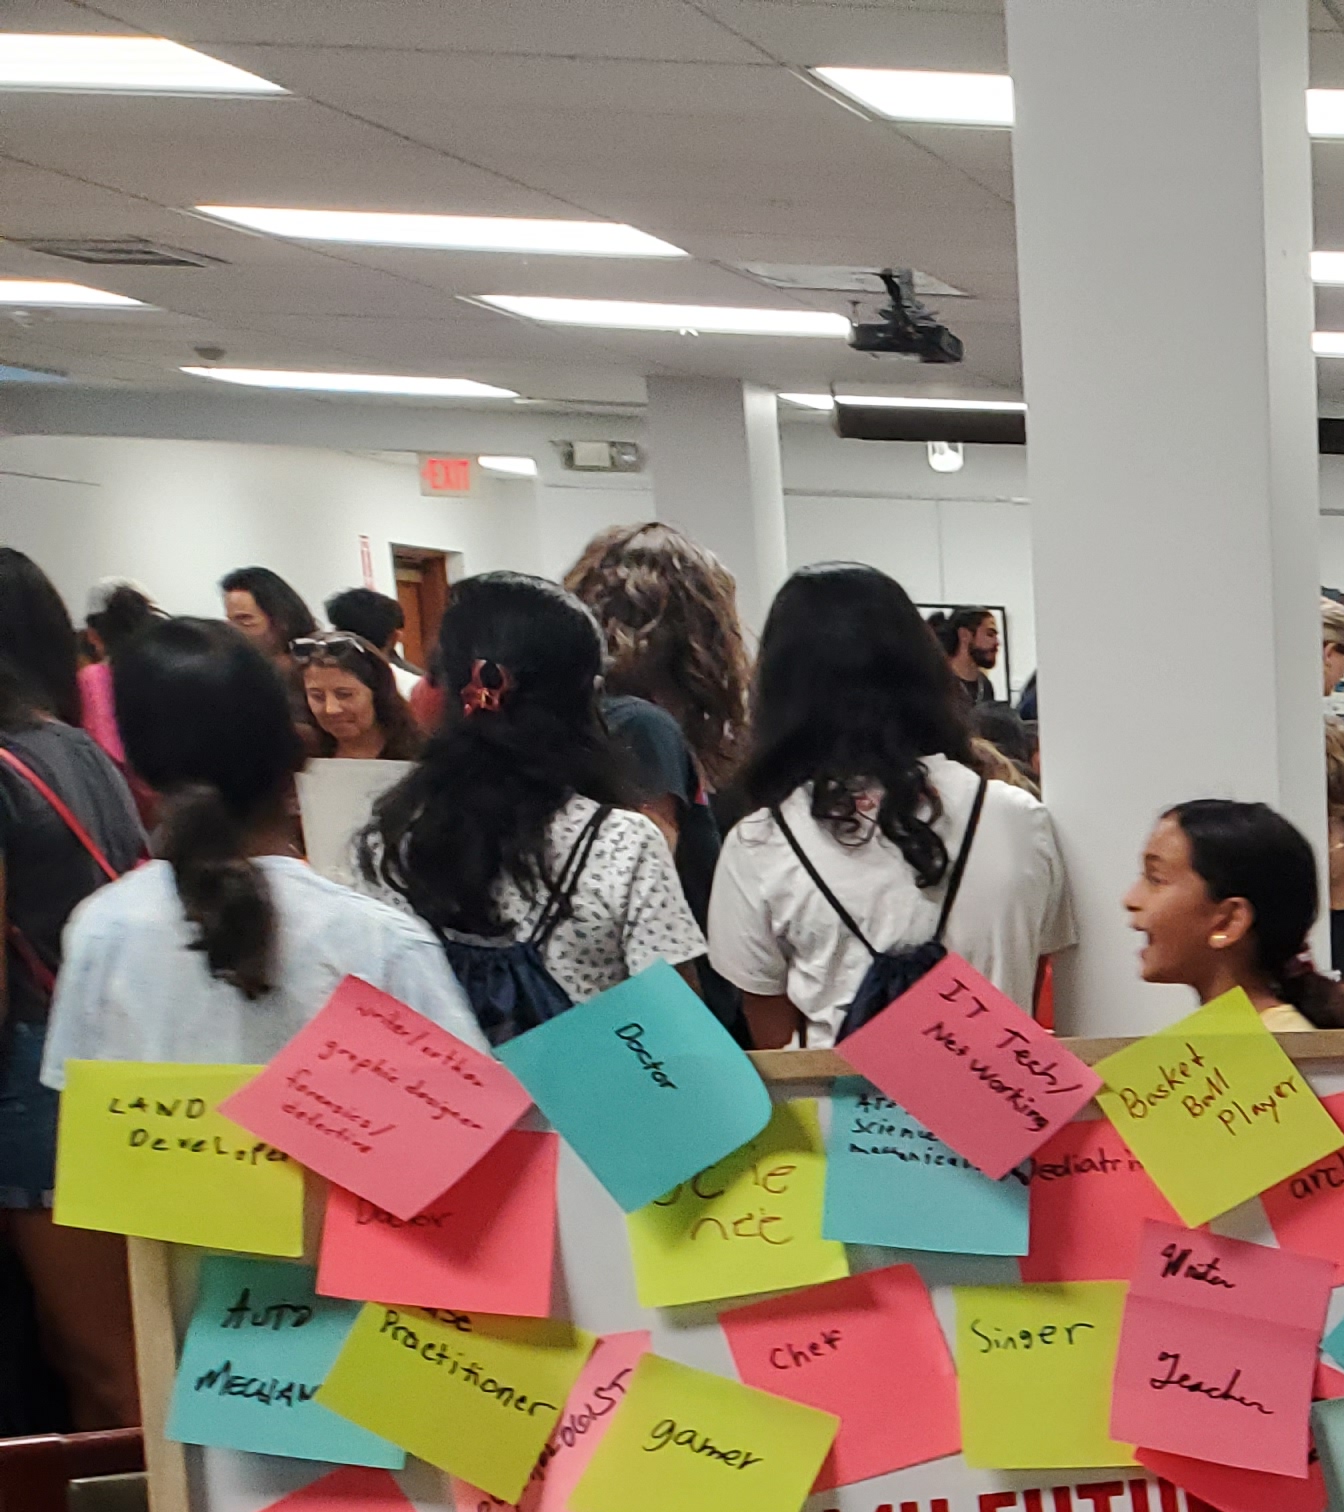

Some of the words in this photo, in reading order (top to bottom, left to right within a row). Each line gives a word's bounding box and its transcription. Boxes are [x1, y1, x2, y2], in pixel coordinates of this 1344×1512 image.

[940, 978, 991, 1018] IT
[614, 1022, 678, 1092] Doctor
[1118, 1042, 1205, 1120] Basket
[108, 1096, 206, 1121] LAND
[769, 1329, 843, 1371] Chef
[970, 1318, 1096, 1355] Singer
[642, 1418, 764, 1472] gamer
